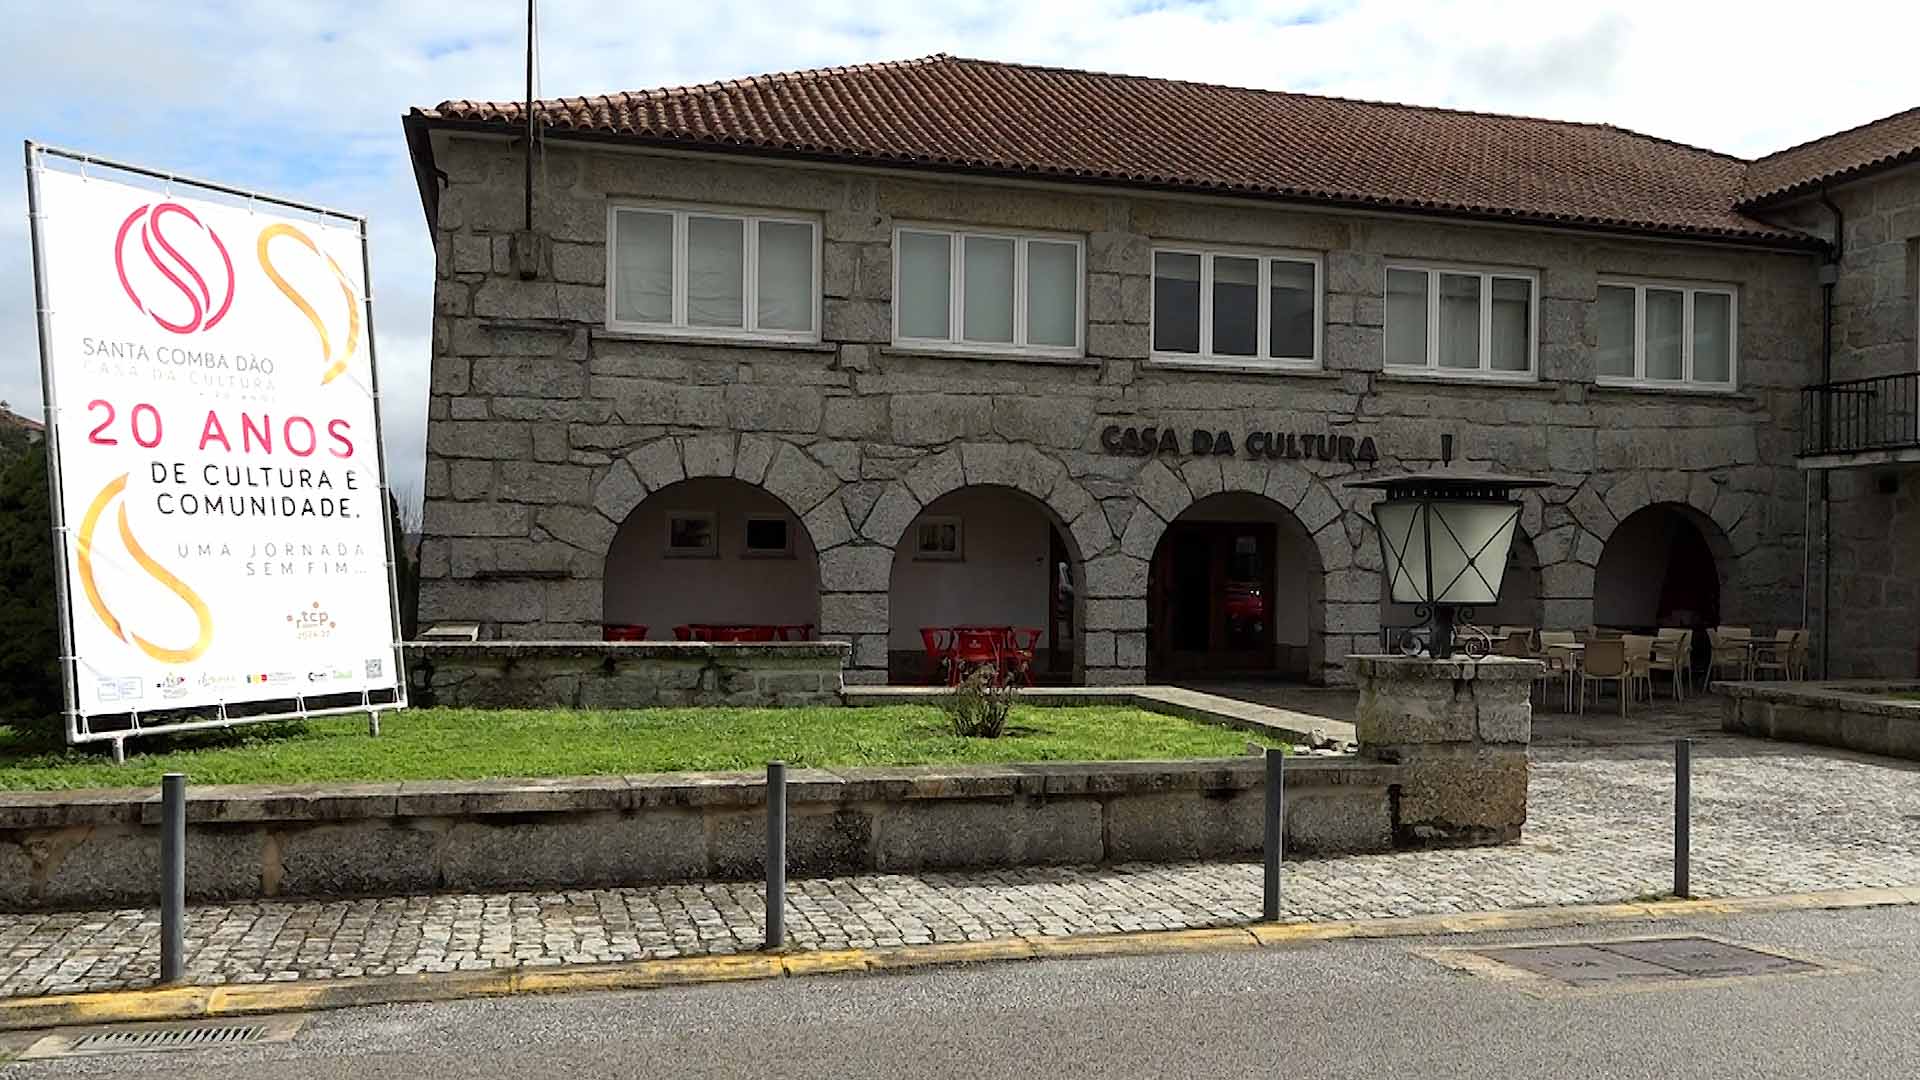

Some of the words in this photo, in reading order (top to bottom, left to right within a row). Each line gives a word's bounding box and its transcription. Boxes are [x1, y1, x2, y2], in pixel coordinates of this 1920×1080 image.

[82, 336, 150, 361] SANTA
[156, 345, 229, 369] COMBA
[189, 370, 276, 391] CULTURA
[87, 399, 163, 448] 20
[199, 409, 355, 459] ANOS
[1101, 426, 1180, 457] CASA
[1192, 429, 1235, 456] DA
[1245, 430, 1379, 462] CULTURA
[151, 461, 186, 484] DE
[203, 464, 333, 490] CULTURA
[346, 469, 359, 490] E
[157, 493, 361, 518] COMUNIDADE.
[177, 542, 232, 558] UMA
[249, 541, 365, 558] JORNADA
[245, 561, 294, 576] SEM
